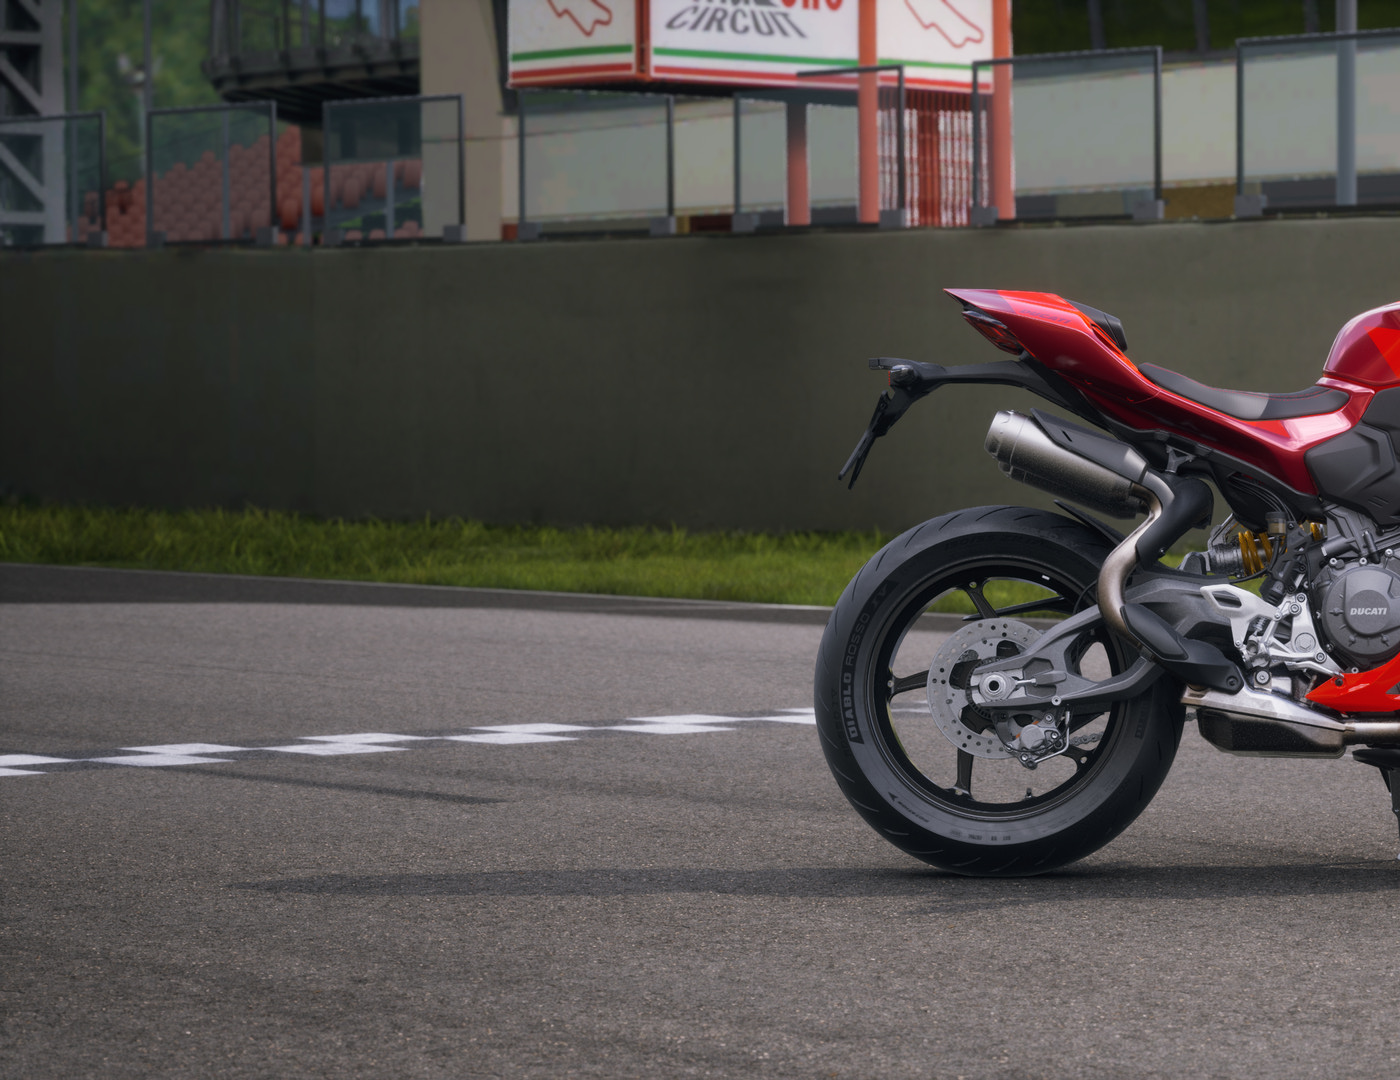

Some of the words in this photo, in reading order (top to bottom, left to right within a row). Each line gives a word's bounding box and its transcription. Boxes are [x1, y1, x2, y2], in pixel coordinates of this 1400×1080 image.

[665, 5, 808, 39] CIRCUIT
[1019, 309, 1071, 324] DUCATI
[1349, 607, 1388, 616] DUCATI
[845, 612, 870, 666] ROSSO
[842, 672, 858, 739] DIABLO
